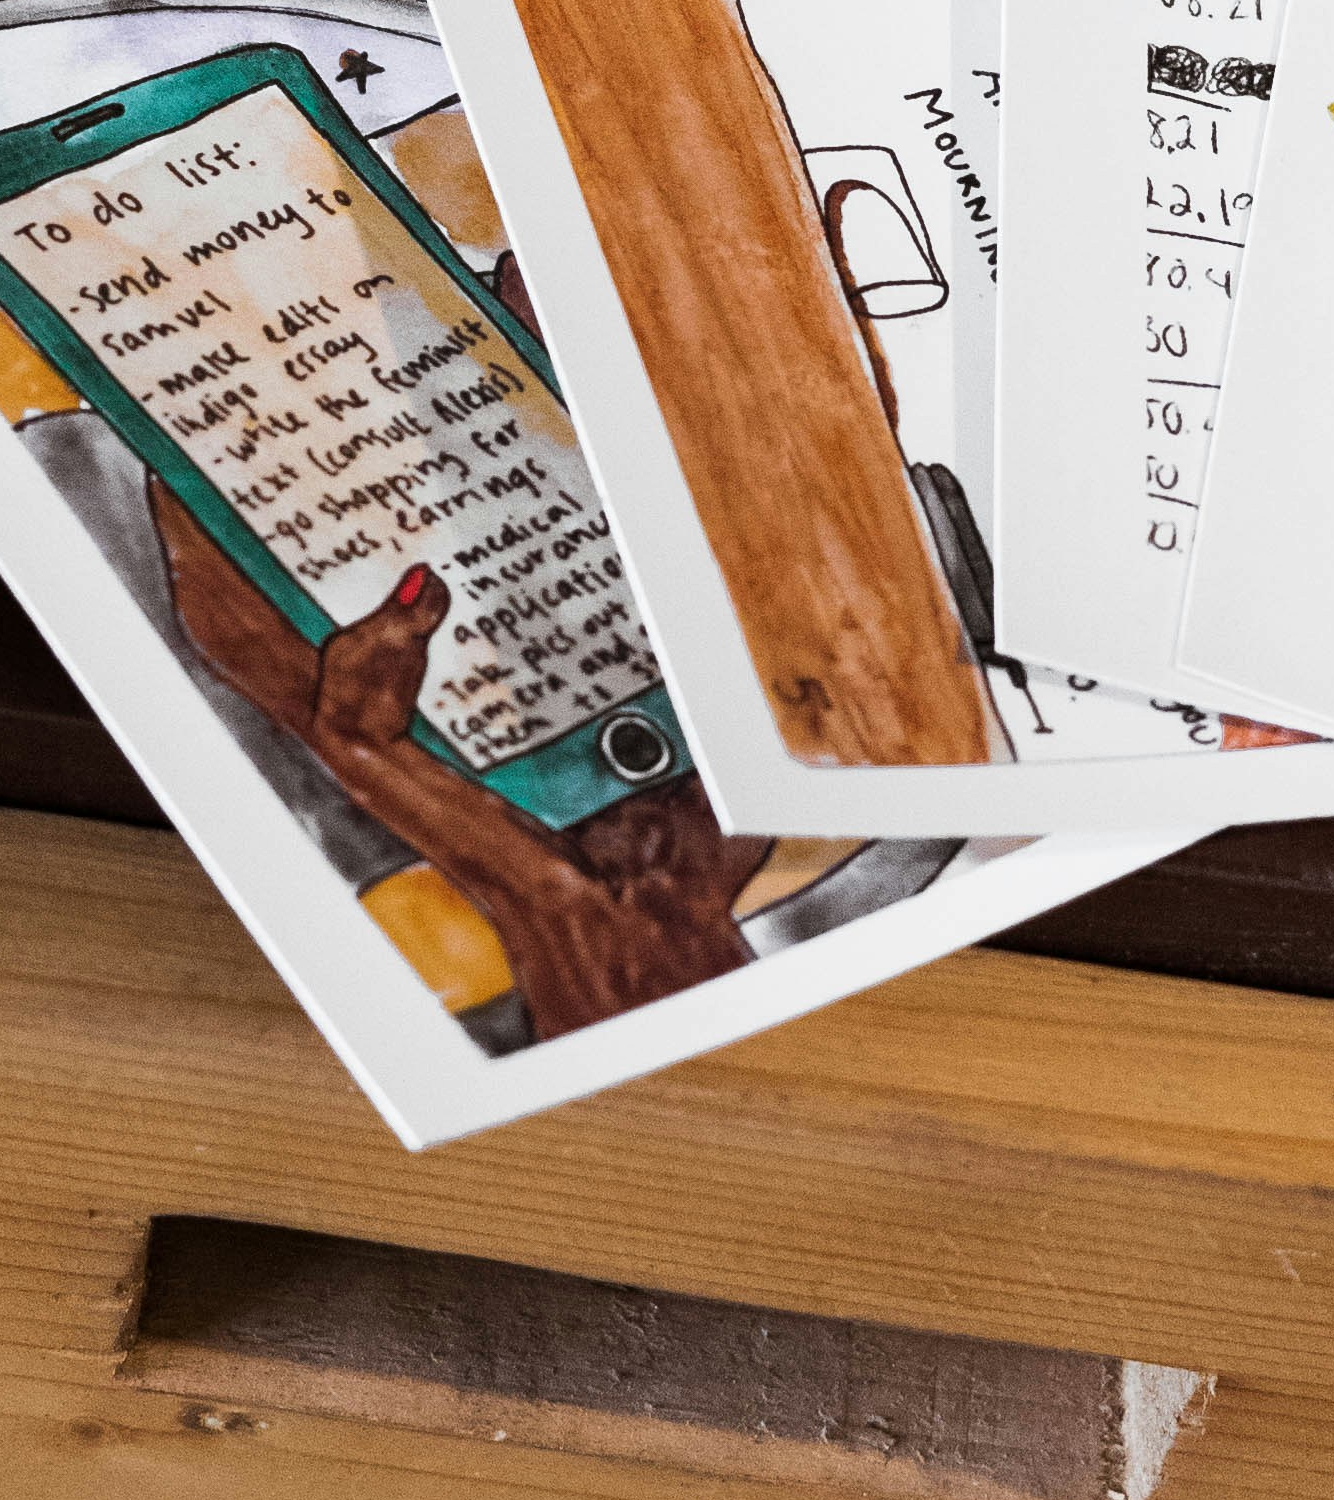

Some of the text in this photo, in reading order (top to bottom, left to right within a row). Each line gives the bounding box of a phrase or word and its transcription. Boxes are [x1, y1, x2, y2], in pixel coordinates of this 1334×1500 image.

[1147, 109, 1219, 155] 8.21
[13, 141, 257, 252] To do list:
[183, 203, 316, 267] money
[305, 187, 353, 216] to
[903, 87, 998, 284] MOURNIN
[352, 272, 396, 301] on
[164, 331, 379, 438] indigo essay
[315, 388, 370, 422] the
[370, 316, 489, 394] feminist
[231, 462, 301, 511] text
[318, 449, 471, 523] shopping
[470, 417, 520, 459] for
[395, 456, 548, 534] earrings
[453, 550, 624, 648] applicatio
